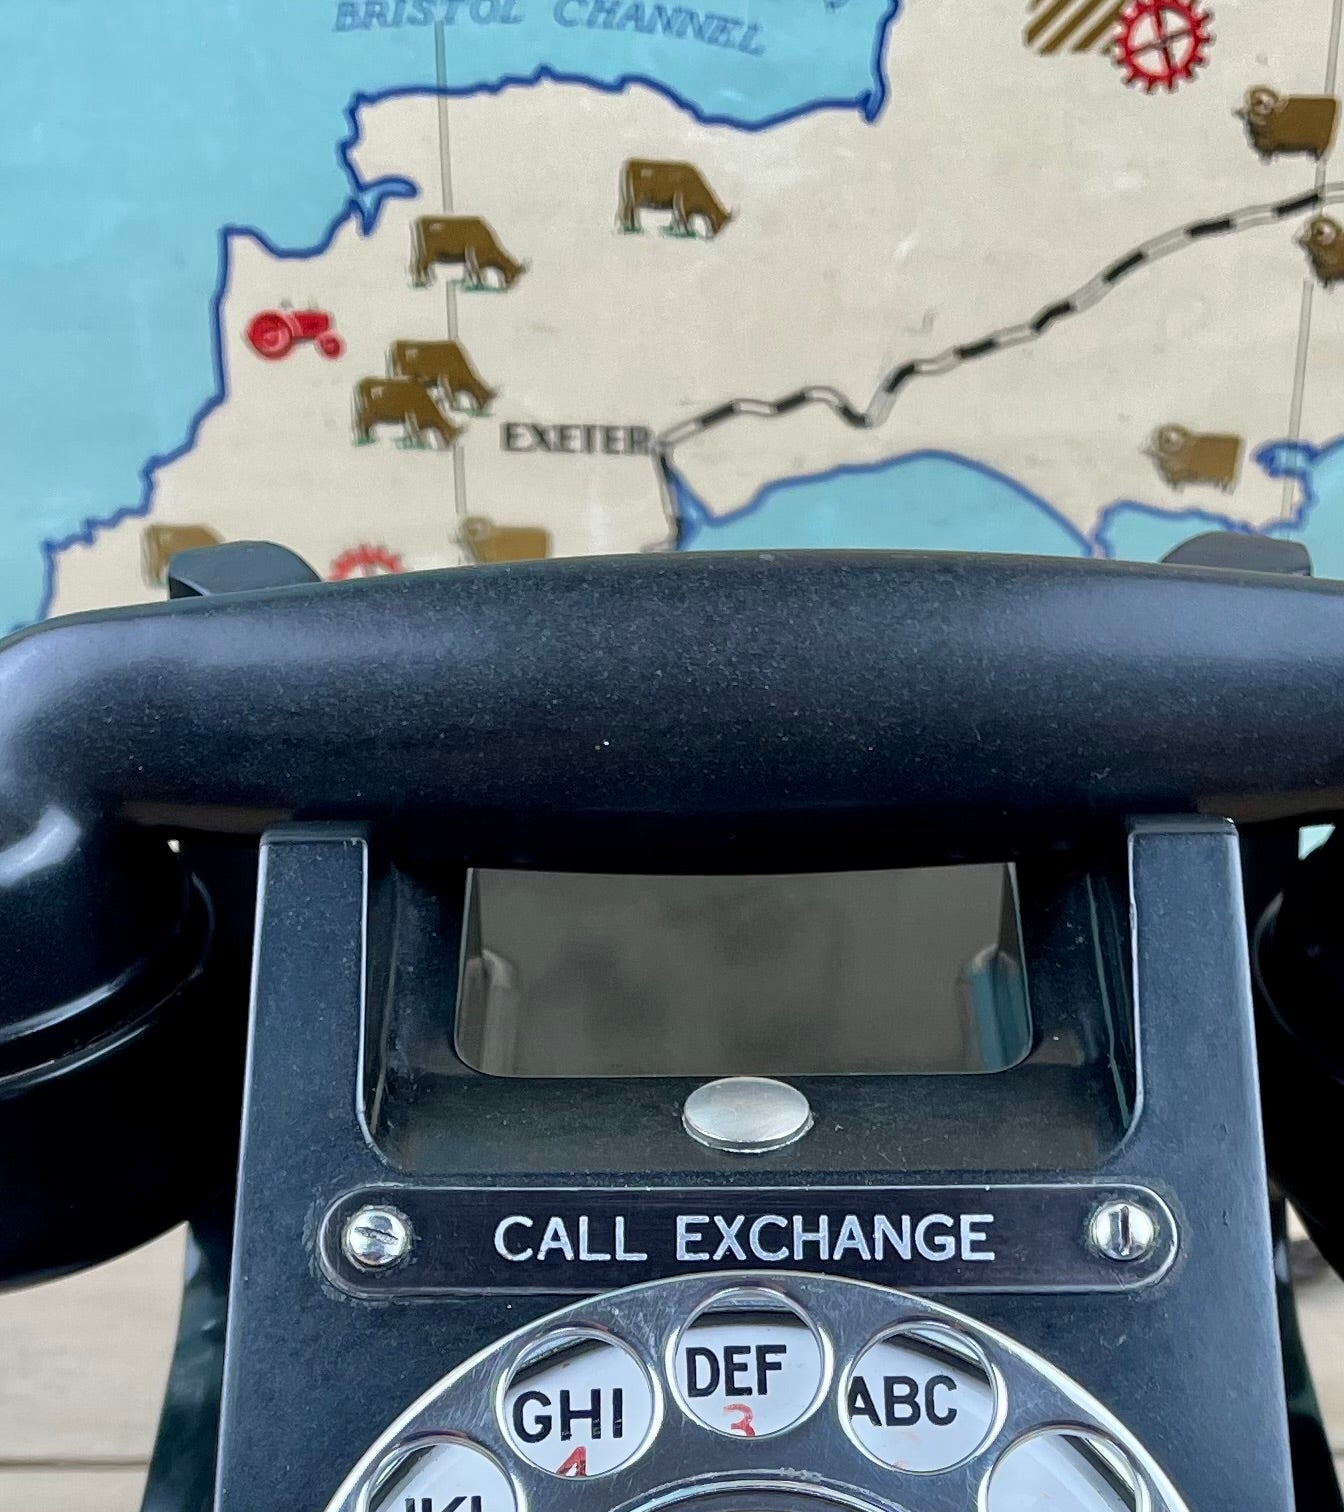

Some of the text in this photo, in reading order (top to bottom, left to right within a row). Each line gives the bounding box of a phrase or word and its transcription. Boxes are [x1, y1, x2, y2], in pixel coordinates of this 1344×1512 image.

[553, 0, 767, 56] CHANNEL
[501, 422, 653, 456] EXETER
[494, 1212, 996, 1263] CALL EXCHANGE
[685, 1343, 787, 1398] DEF
[512, 1386, 624, 1443] GHI
[722, 1403, 756, 1438] 3
[848, 1374, 958, 1427] ABC
